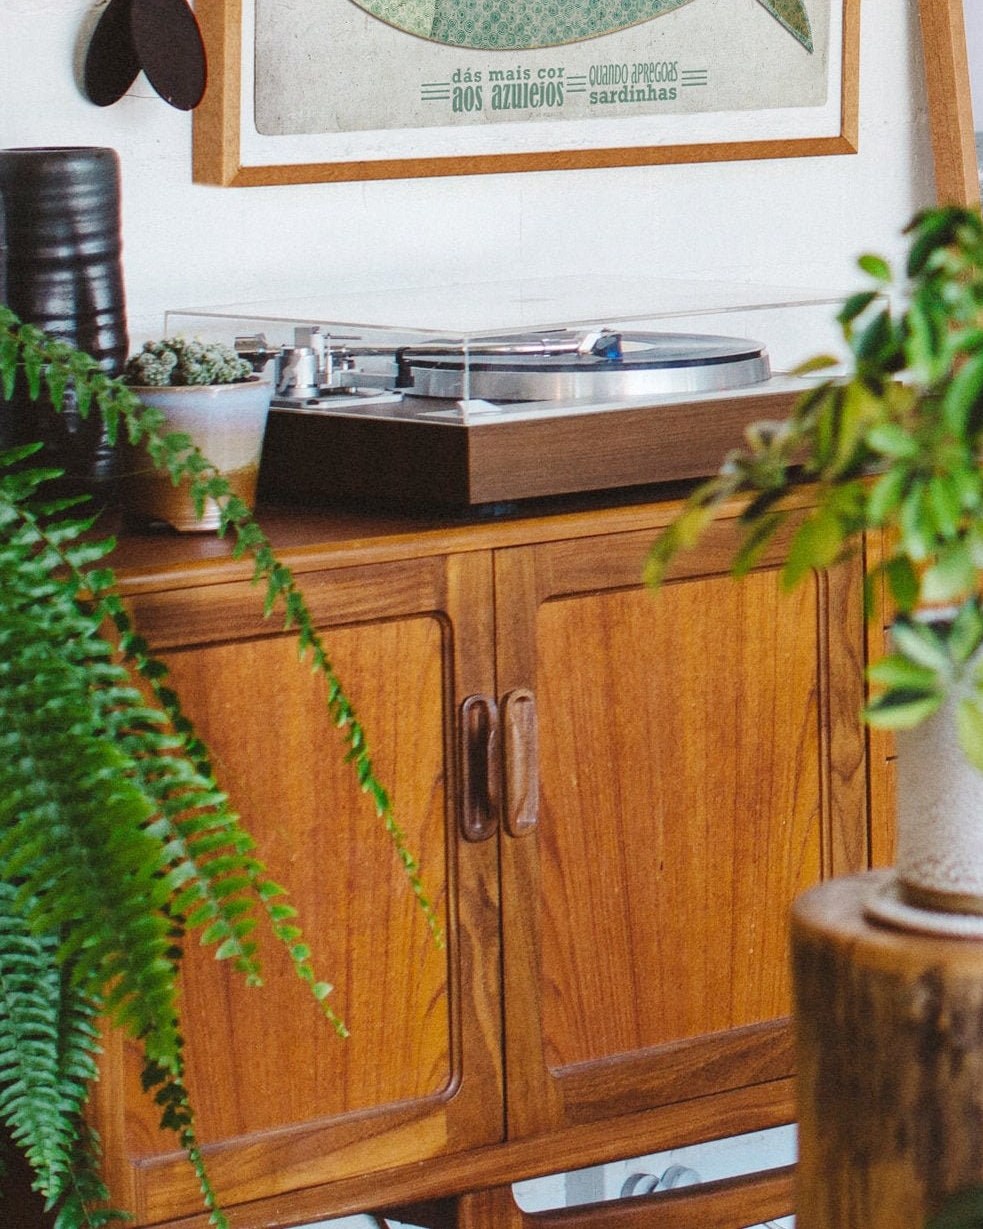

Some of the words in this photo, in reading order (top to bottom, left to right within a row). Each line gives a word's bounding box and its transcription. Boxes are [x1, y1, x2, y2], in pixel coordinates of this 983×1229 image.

[452, 68, 482, 83] dás
[489, 65, 531, 81] mais
[537, 67, 565, 79] cor
[452, 85, 483, 112] aos
[491, 81, 564, 110] azulejos
[589, 84, 677, 104] sardinhas
